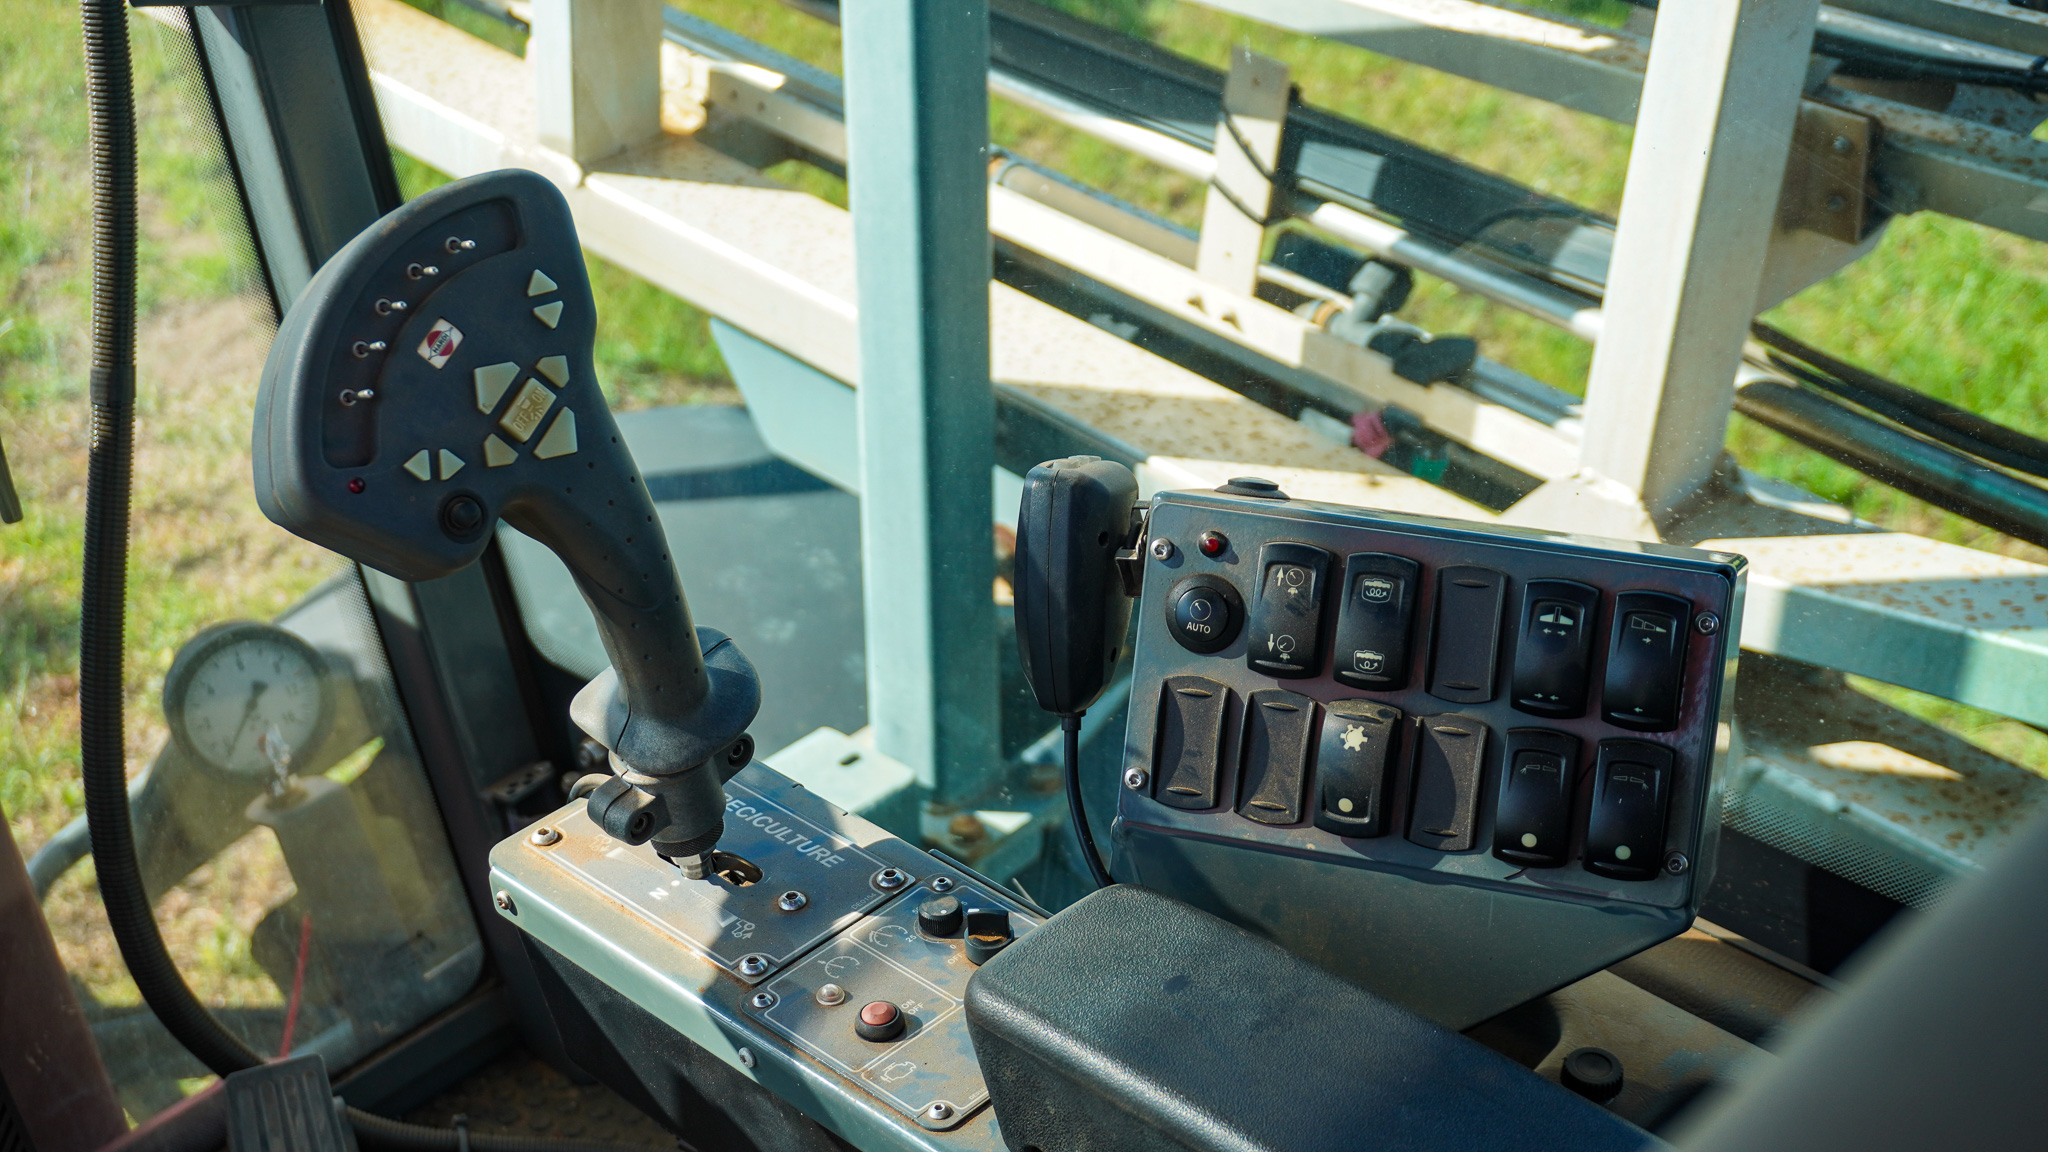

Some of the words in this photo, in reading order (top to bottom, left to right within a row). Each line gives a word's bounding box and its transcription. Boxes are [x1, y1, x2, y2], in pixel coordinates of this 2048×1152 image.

[432, 333, 450, 353] HARDI
[531, 386, 548, 403] ON
[513, 411, 530, 431] OFF
[1186, 621, 1211, 634] AUTO
[649, 887, 669, 900] N
[905, 934, 917, 943] 25
[901, 998, 915, 1009] ON
[908, 1001, 924, 1015] OFF
